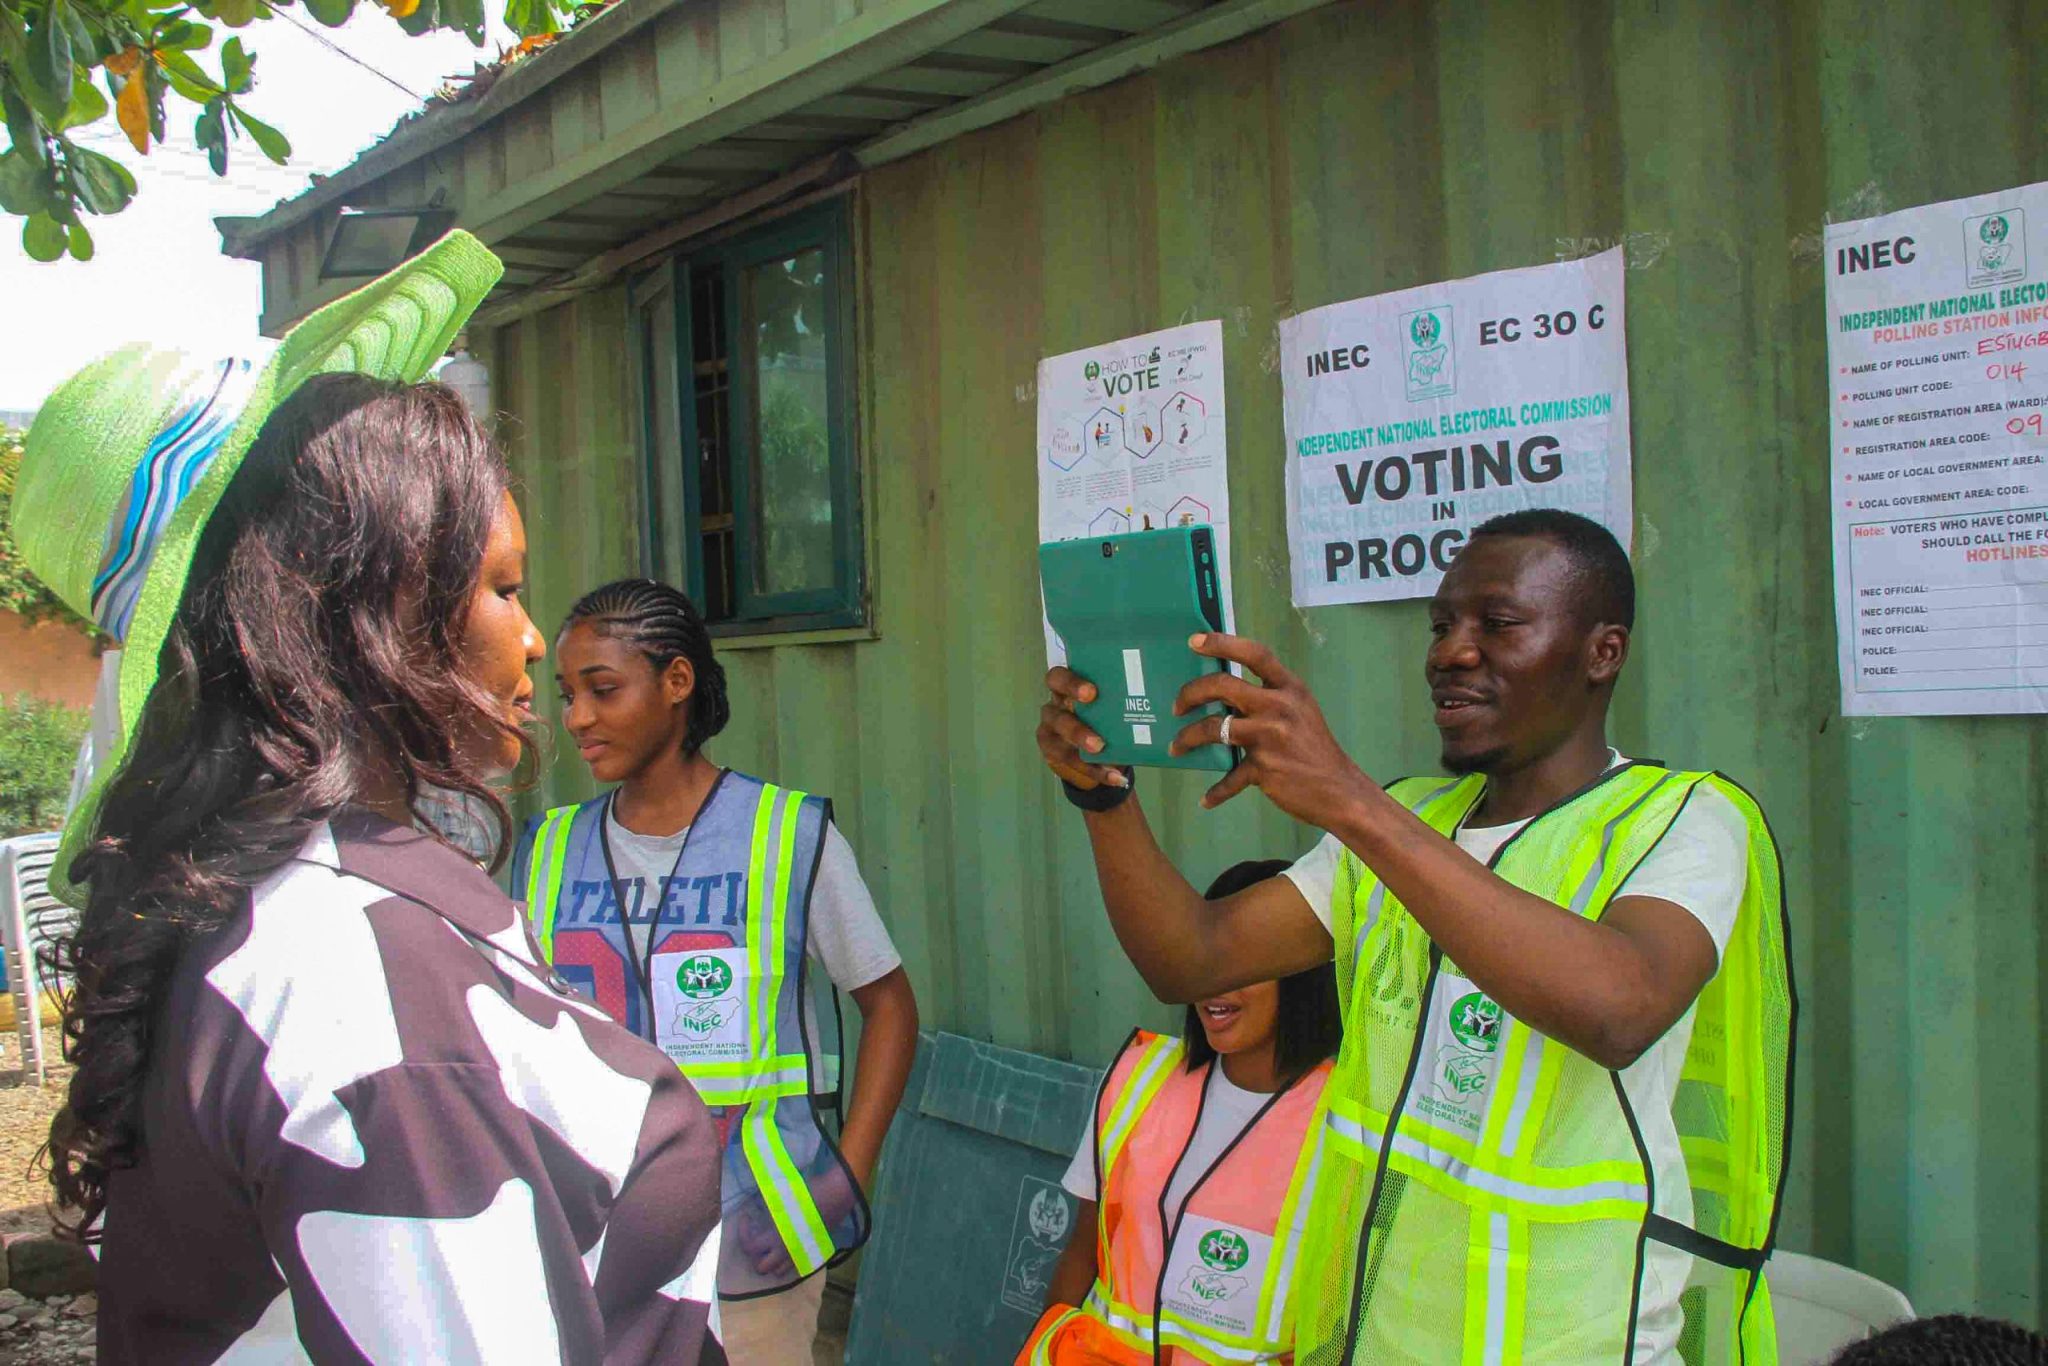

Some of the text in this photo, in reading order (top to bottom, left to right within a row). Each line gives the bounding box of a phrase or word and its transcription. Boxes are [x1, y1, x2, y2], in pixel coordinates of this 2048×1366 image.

[1838, 236, 1916, 275] INEC
[1840, 282, 2048, 332] INDEPENDENT NATIONAL ELECTO
[1479, 304, 1605, 346] EC 30 C
[1874, 322, 1938, 344] POLLING
[1944, 312, 2010, 334] STATION
[1102, 354, 1148, 375] HOW TO
[1306, 344, 1370, 378] INEC
[1852, 350, 1970, 375] NAME OF POLLING UNIT:
[1987, 362, 2028, 382] 014
[1103, 367, 1160, 397] VOTE
[1852, 381, 1953, 402] POLLING UNIT CODE:
[1853, 398, 2047, 428] NAME OF REGISTRATION AREA (WARD):
[1296, 394, 1612, 457] INDEPENDENT NATIONAL ELECTORAL COMMISSION
[2006, 414, 2042, 435] 09
[1856, 432, 1991, 455] REGISTRATION AREA CODE:
[1335, 435, 1564, 505] VOTING
[1858, 455, 2044, 482] NAME OF LOCAL GOVERNMENT AREA:
[1858, 486, 2029, 510] LOCAL GOVERNMENT AREA: CODE:
[1432, 500, 1455, 521] IN
[1854, 526, 1886, 537] Note:
[1890, 521, 1937, 535] VOTERS
[1940, 519, 1968, 530] WHO
[1971, 515, 2004, 527] HAVE
[1921, 536, 1970, 549] SHOULD
[1974, 533, 2005, 545] CALL
[2008, 530, 2032, 542] THE
[1325, 528, 1468, 582] PROG
[1966, 544, 2048, 562] HOTLINES
[1860, 585, 1929, 596] INEC OFFICIAL:
[1861, 606, 1929, 617] INEC OFFICIAL:
[1862, 625, 1929, 636] INEC OFFICIAL:
[1863, 647, 1897, 656] POLICE:
[1863, 667, 1898, 676] POLICE:
[1125, 698, 1151, 711] INEC
[683, 1014, 721, 1033] INEC
[1444, 1064, 1486, 1094] INEC
[1192, 1279, 1227, 1300] INEC
